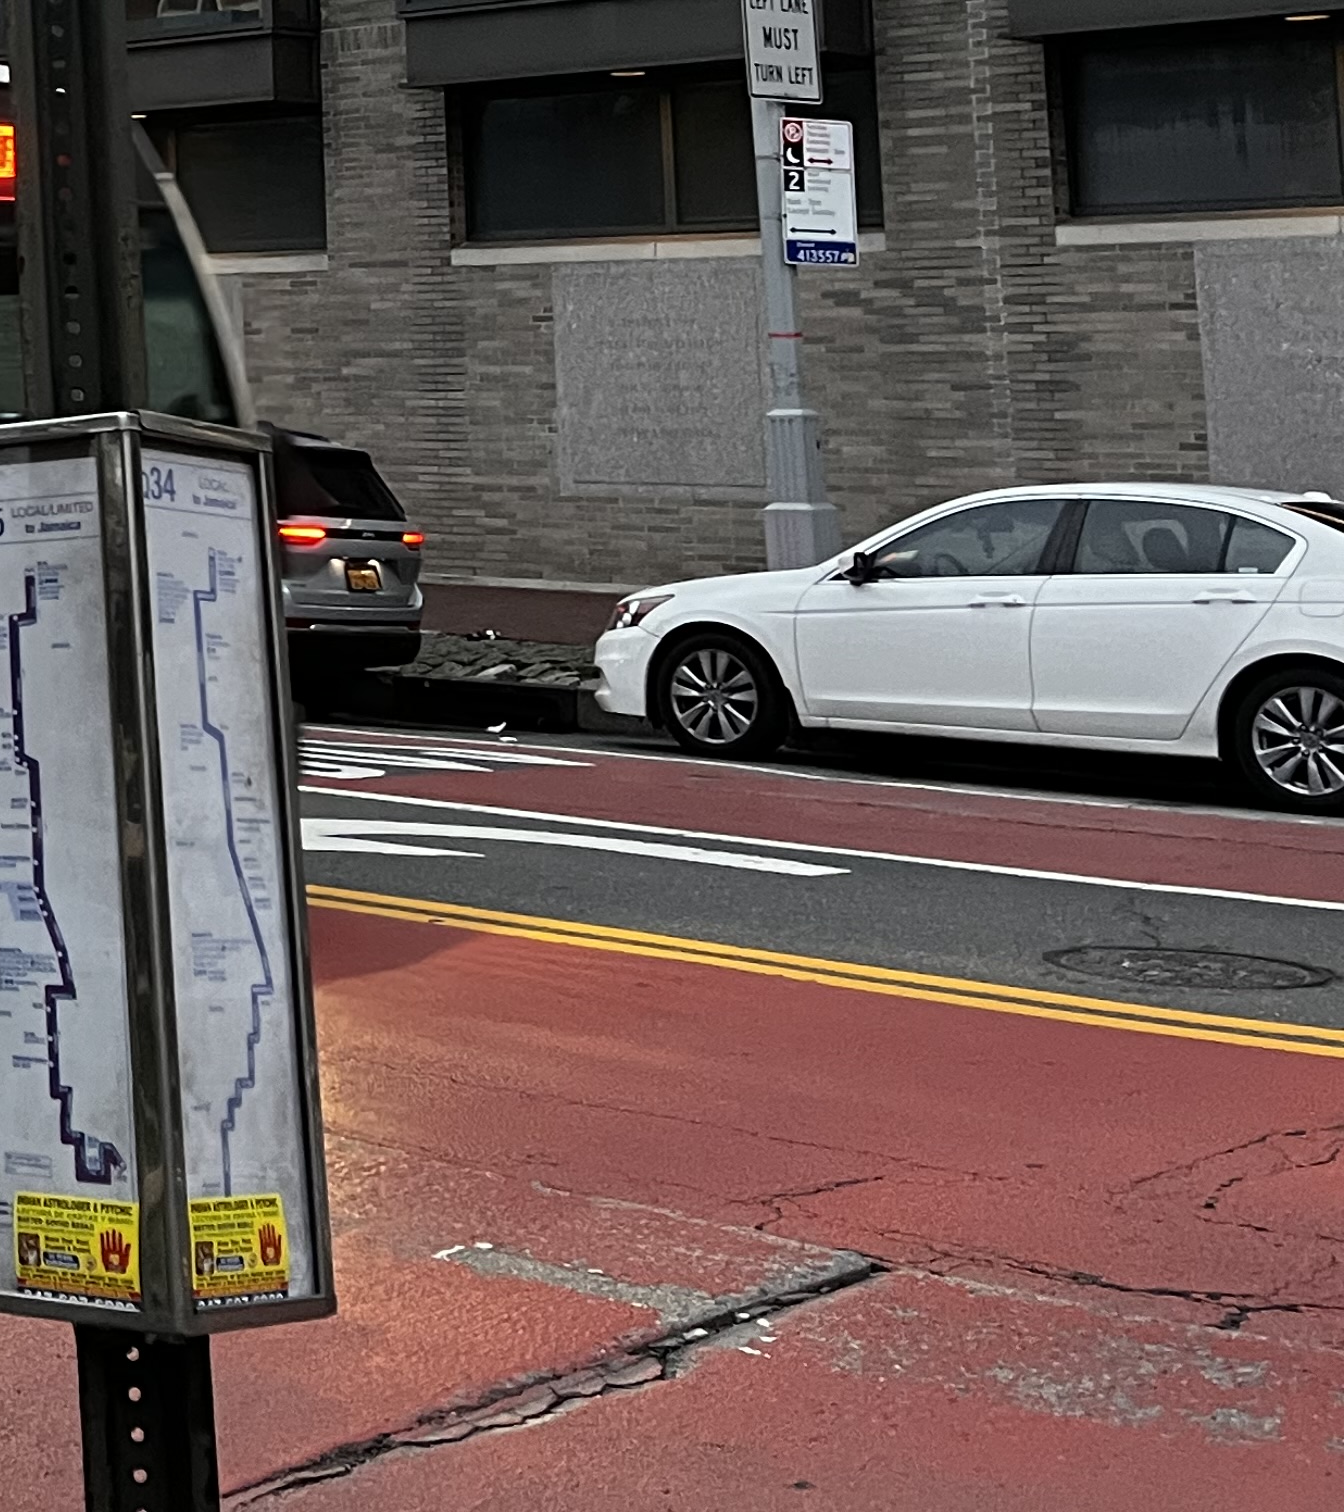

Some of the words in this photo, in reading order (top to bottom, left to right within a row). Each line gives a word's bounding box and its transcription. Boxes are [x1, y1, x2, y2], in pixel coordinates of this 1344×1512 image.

[762, 25, 799, 50] MUST
[754, 62, 783, 83] TURN
[787, 65, 814, 85] LEFT
[788, 171, 801, 190] 2
